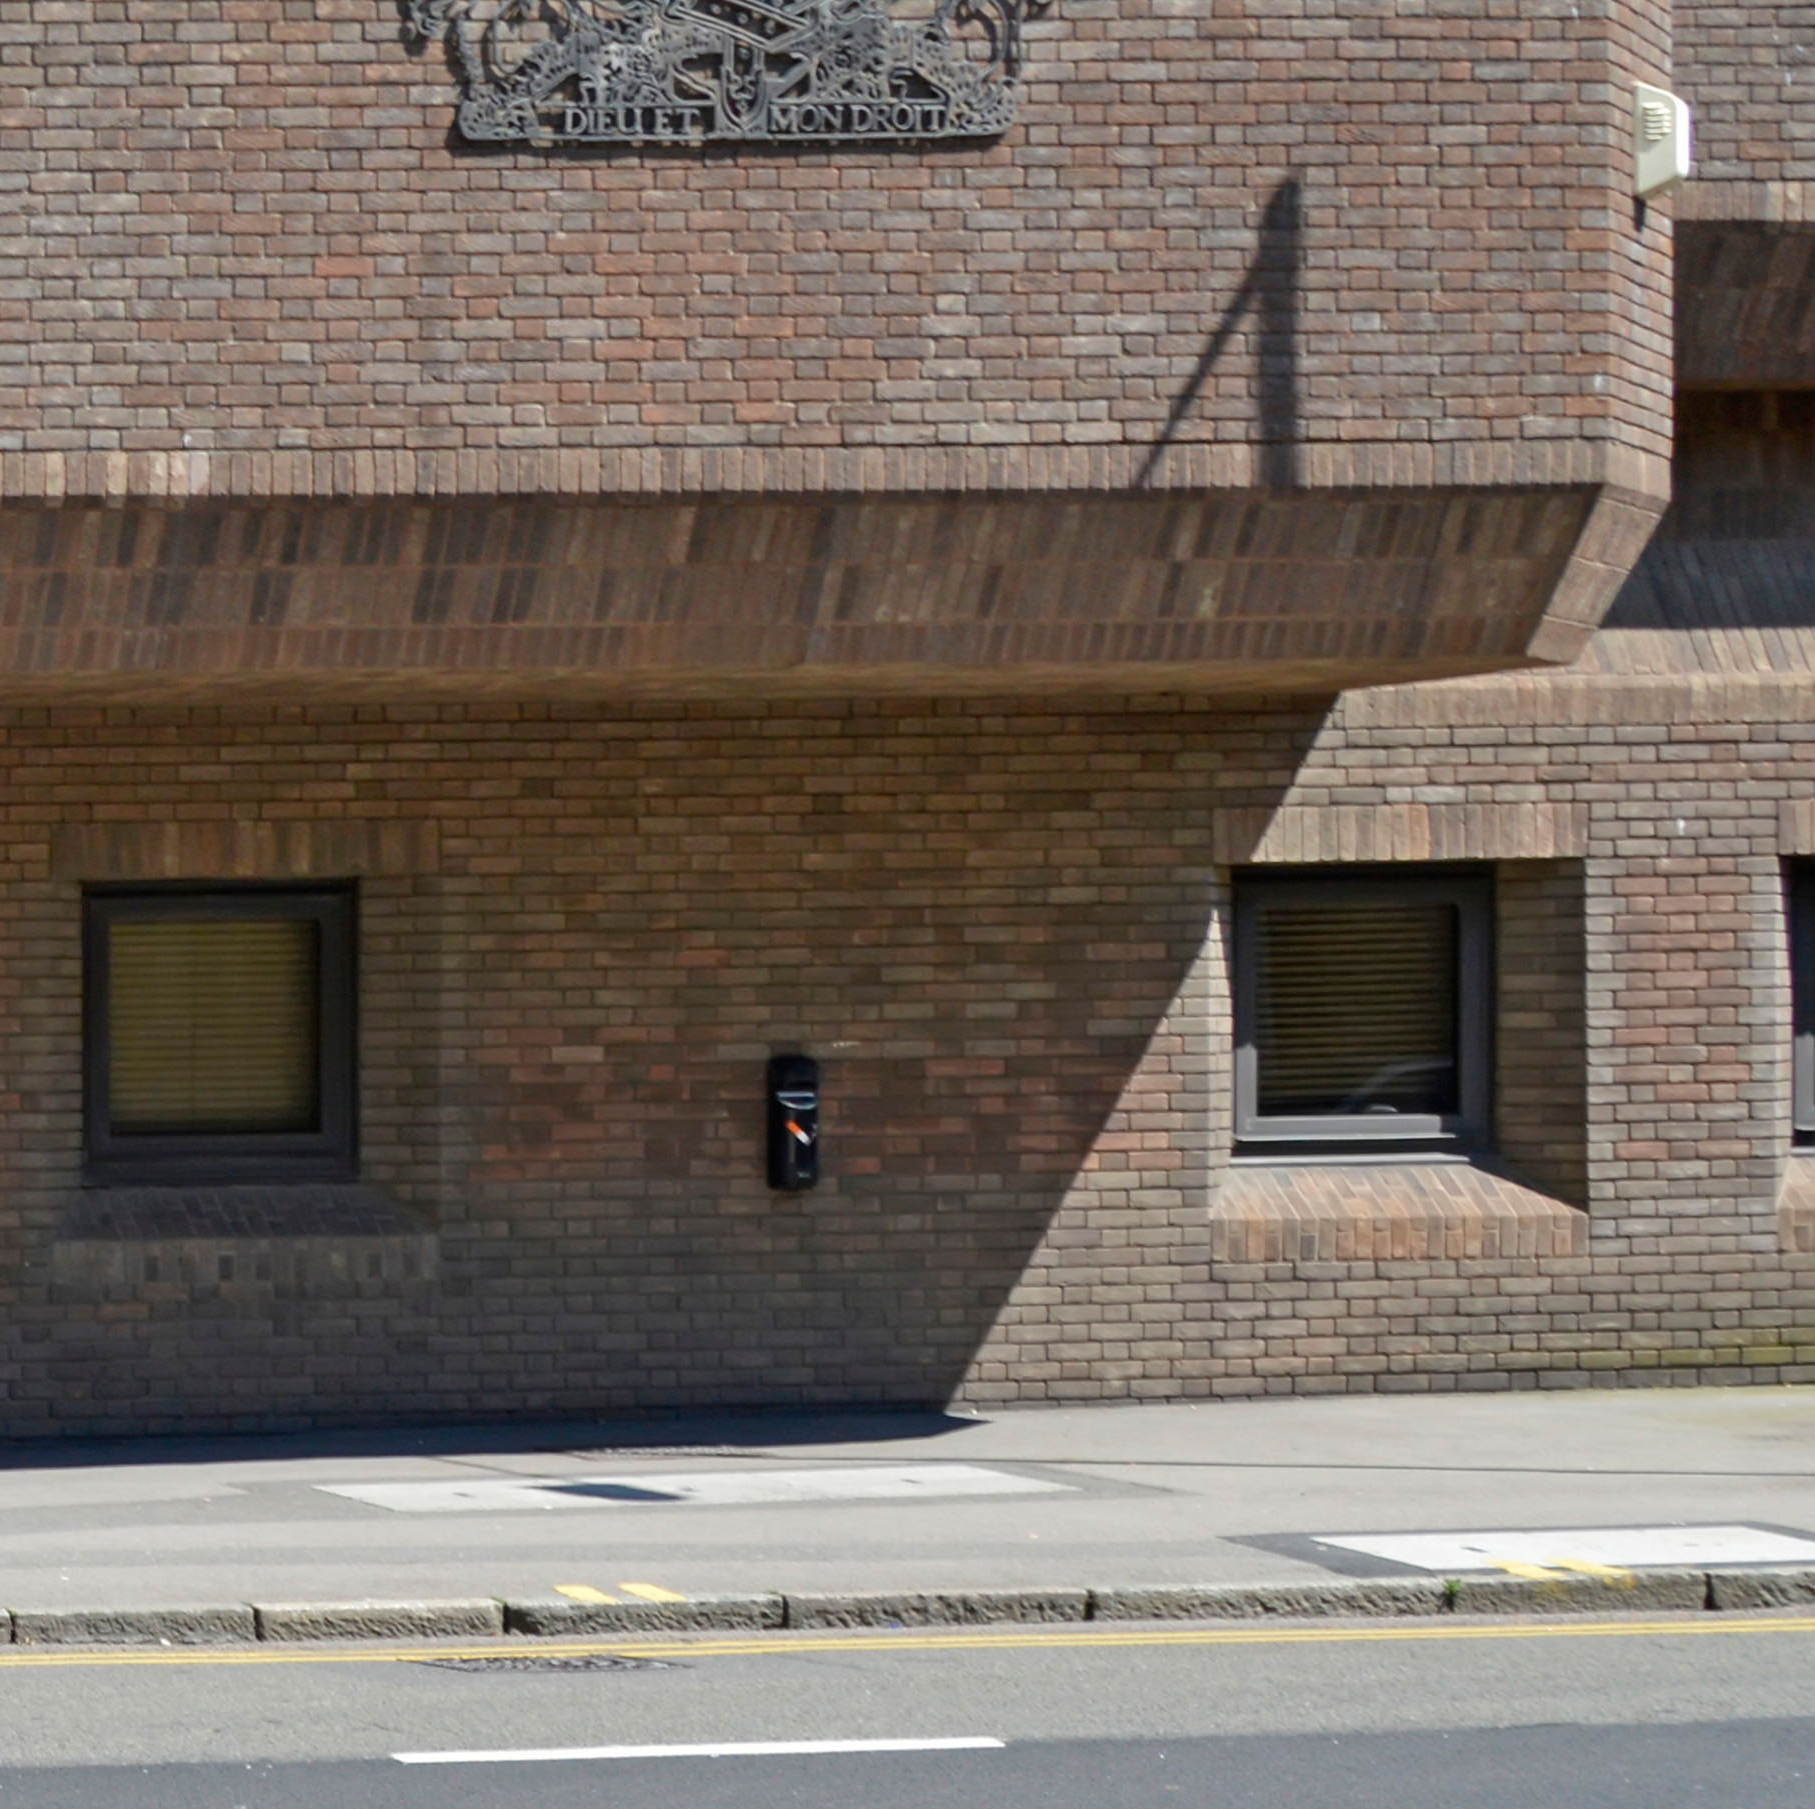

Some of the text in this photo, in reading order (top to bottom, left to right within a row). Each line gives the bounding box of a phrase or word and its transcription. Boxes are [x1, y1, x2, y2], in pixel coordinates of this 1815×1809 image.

[565, 107, 701, 136] DIEU ET
[768, 103, 949, 134] MON DROIT
